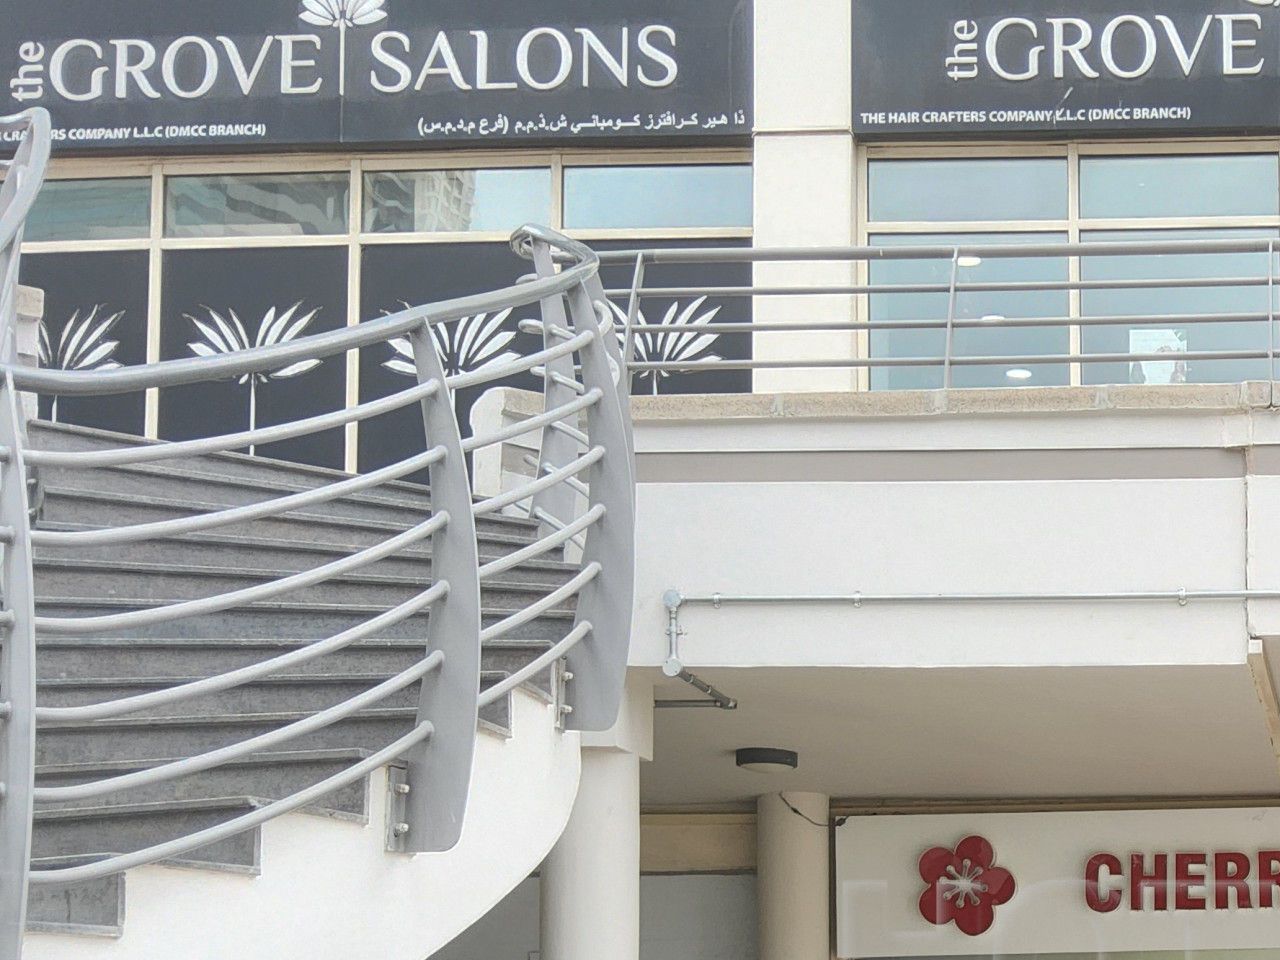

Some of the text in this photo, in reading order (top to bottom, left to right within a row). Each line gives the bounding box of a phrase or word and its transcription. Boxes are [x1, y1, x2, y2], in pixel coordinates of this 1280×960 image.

[10, 41, 45, 101] the
[50, 24, 679, 101] GROVE SALONS
[946, 19, 978, 81] the
[985, 14, 1264, 81] GROVE
[68, 127, 131, 140] COMPANY
[133, 126, 163, 138] L.L.C
[165, 125, 207, 138] (DMCC
[208, 123, 266, 137] BRANCH)
[860, 112, 886, 124] THE
[888, 112, 919, 123] HAIR
[922, 111, 986, 123] CRAFTERS
[989, 110, 1052, 123] COMPANY
[1088, 107, 1131, 122] (DMCC
[1133, 107, 1192, 120] BRANCH)
